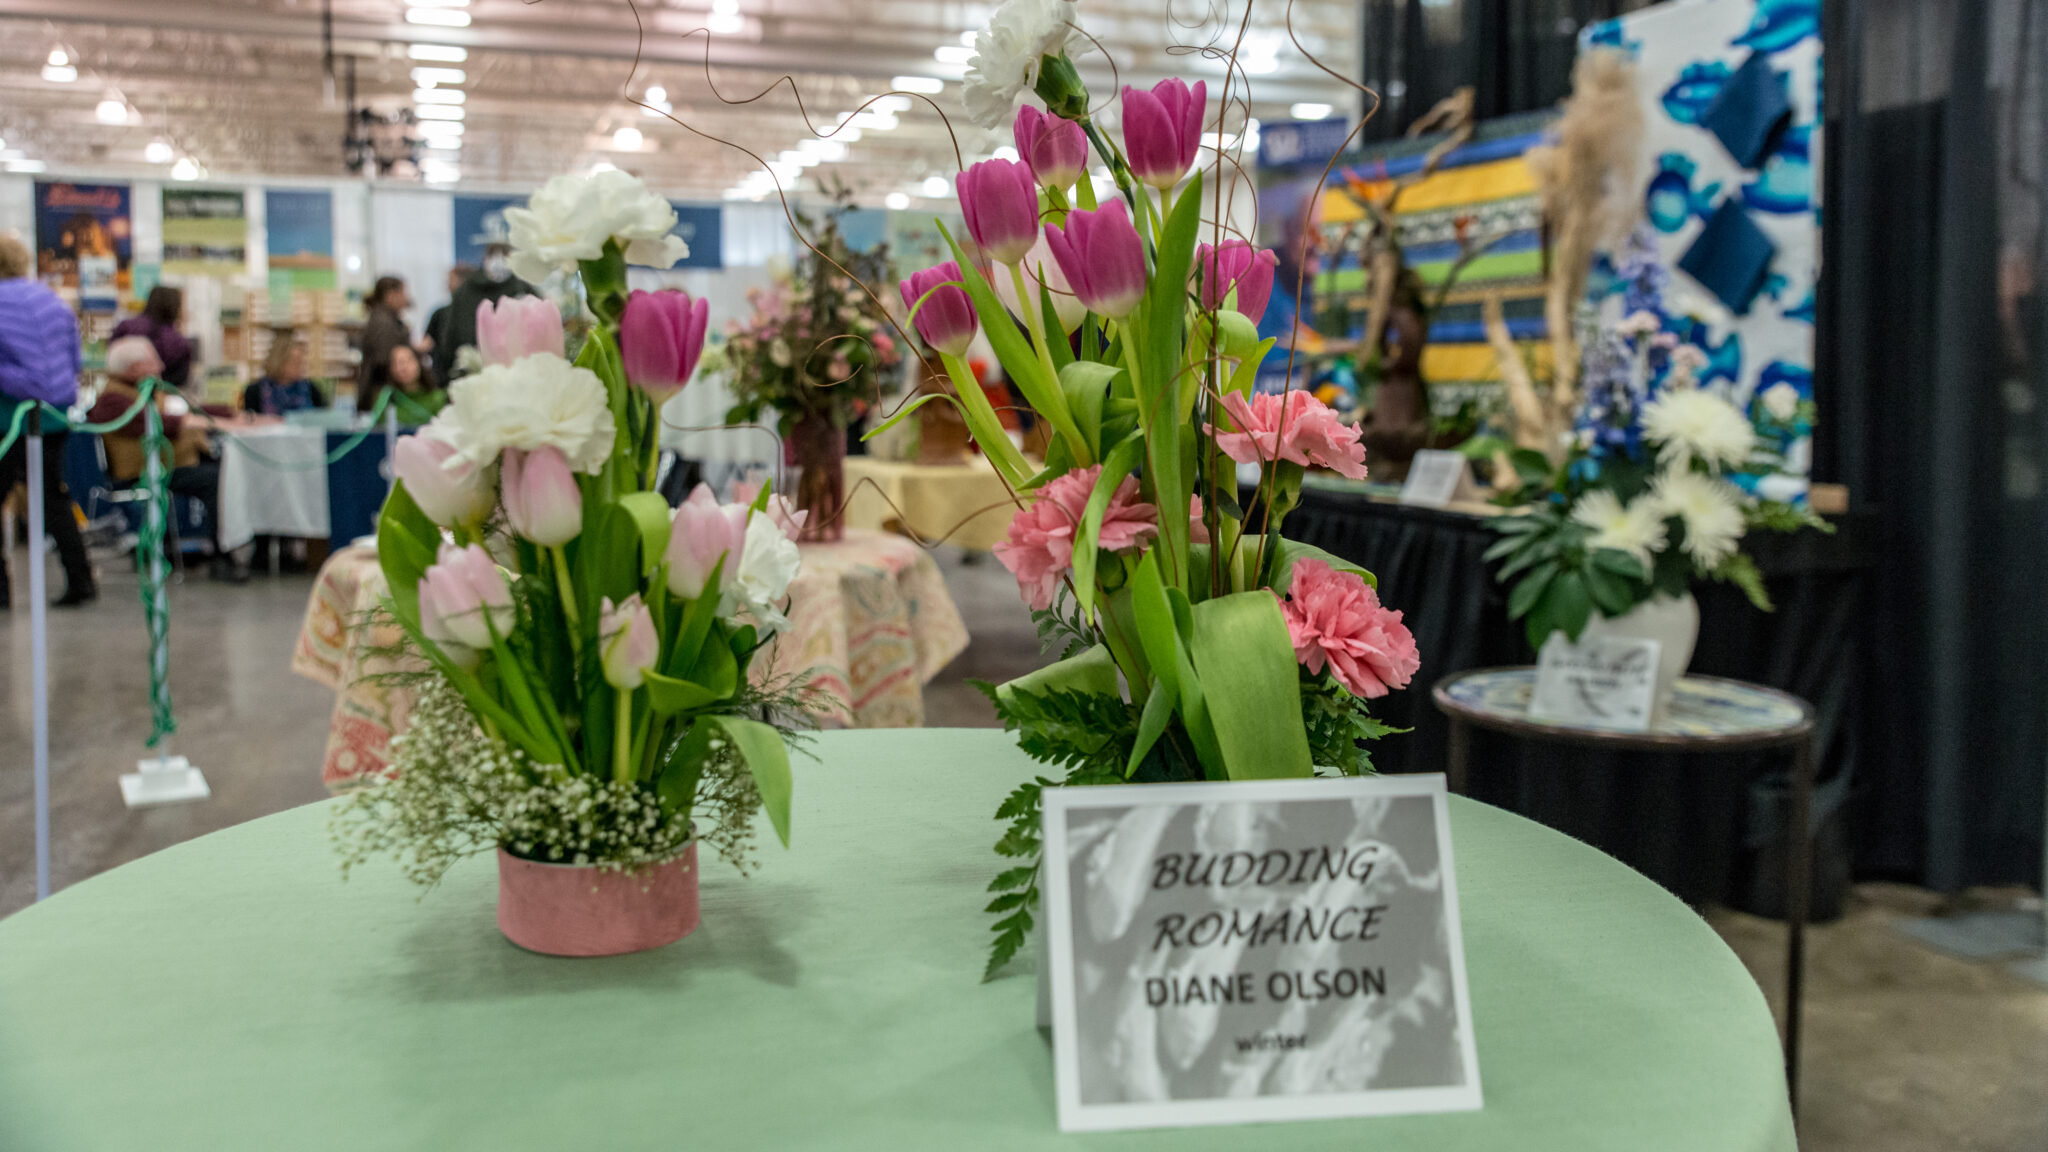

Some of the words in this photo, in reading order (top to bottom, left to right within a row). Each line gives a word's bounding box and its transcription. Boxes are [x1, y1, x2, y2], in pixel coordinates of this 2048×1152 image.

[1153, 846, 1378, 890] BUDDING
[1153, 905, 1388, 950] ROMANCE
[1146, 972, 1256, 1007] DIANE
[1267, 967, 1386, 1002] OLSON
[1235, 1030, 1306, 1052] winter
